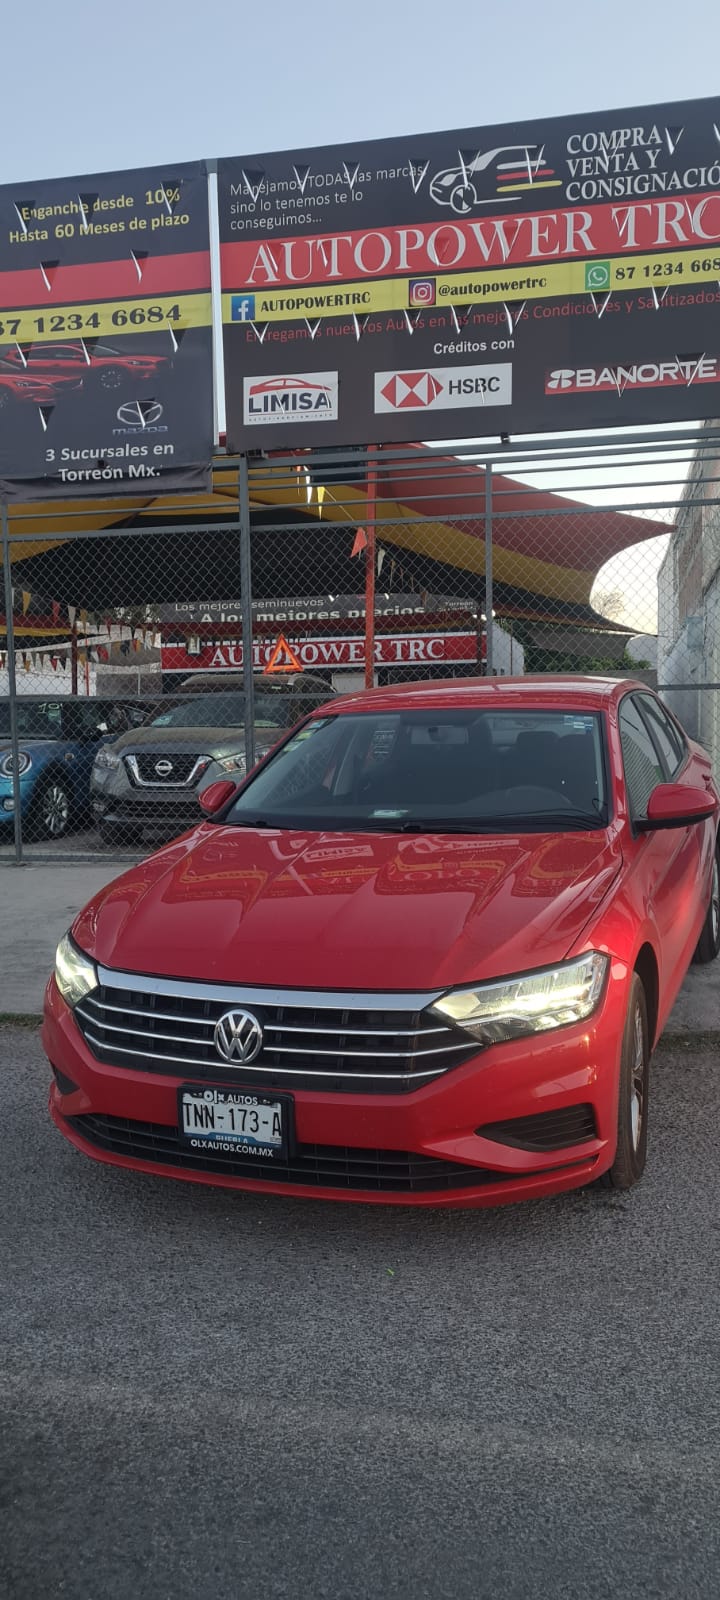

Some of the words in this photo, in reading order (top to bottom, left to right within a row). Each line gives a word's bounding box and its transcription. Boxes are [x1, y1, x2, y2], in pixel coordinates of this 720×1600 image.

[566, 124, 664, 155] COMPRA
[566, 154, 641, 178] VENTA
[645, 148, 662, 169] Y
[308, 173, 350, 187] TODAS
[93, 195, 134, 212] desde
[230, 201, 256, 215] sino
[261, 199, 272, 211] lo
[276, 195, 331, 210] tenemos
[335, 191, 348, 203] te
[351, 189, 364, 202] lo
[9, 226, 48, 244] Hasta
[54, 222, 75, 239] 60
[79, 218, 125, 237] Meses
[129, 214, 147, 230] de
[151, 212, 190, 234] plazo
[245, 210, 597, 284] AUTOPOWER
[611, 195, 720, 248] TRC
[615, 266, 636, 281] 87
[643, 261, 684, 279] 1234
[438, 276, 547, 297] @autopowertrc
[260, 291, 371, 312] AUTOPOWERTRC
[34, 312, 101, 334] 1234
[112, 304, 182, 326] 6684
[429, 317, 446, 328] en
[625, 299, 633, 313] y
[433, 339, 487, 356] Créditos
[491, 339, 515, 352] con
[576, 358, 717, 389] BANORTE
[448, 376, 501, 395] HSBC
[248, 391, 332, 414] LIMISA
[45, 448, 55, 462] 3
[60, 443, 148, 462] Sucursales
[153, 443, 175, 456] en
[58, 464, 124, 482] Torreón
[128, 462, 161, 478] Mx.
[175, 603, 194, 612] Los
[199, 602, 242, 613] mejore
[200, 612, 213, 623] A
[391, 638, 445, 661] TRC
[228, 1094, 258, 1106] AUTOS
[183, 1103, 282, 1137] TNN-173-A
[190, 1139, 274, 1157] OLXAUTOS.COM.MX
